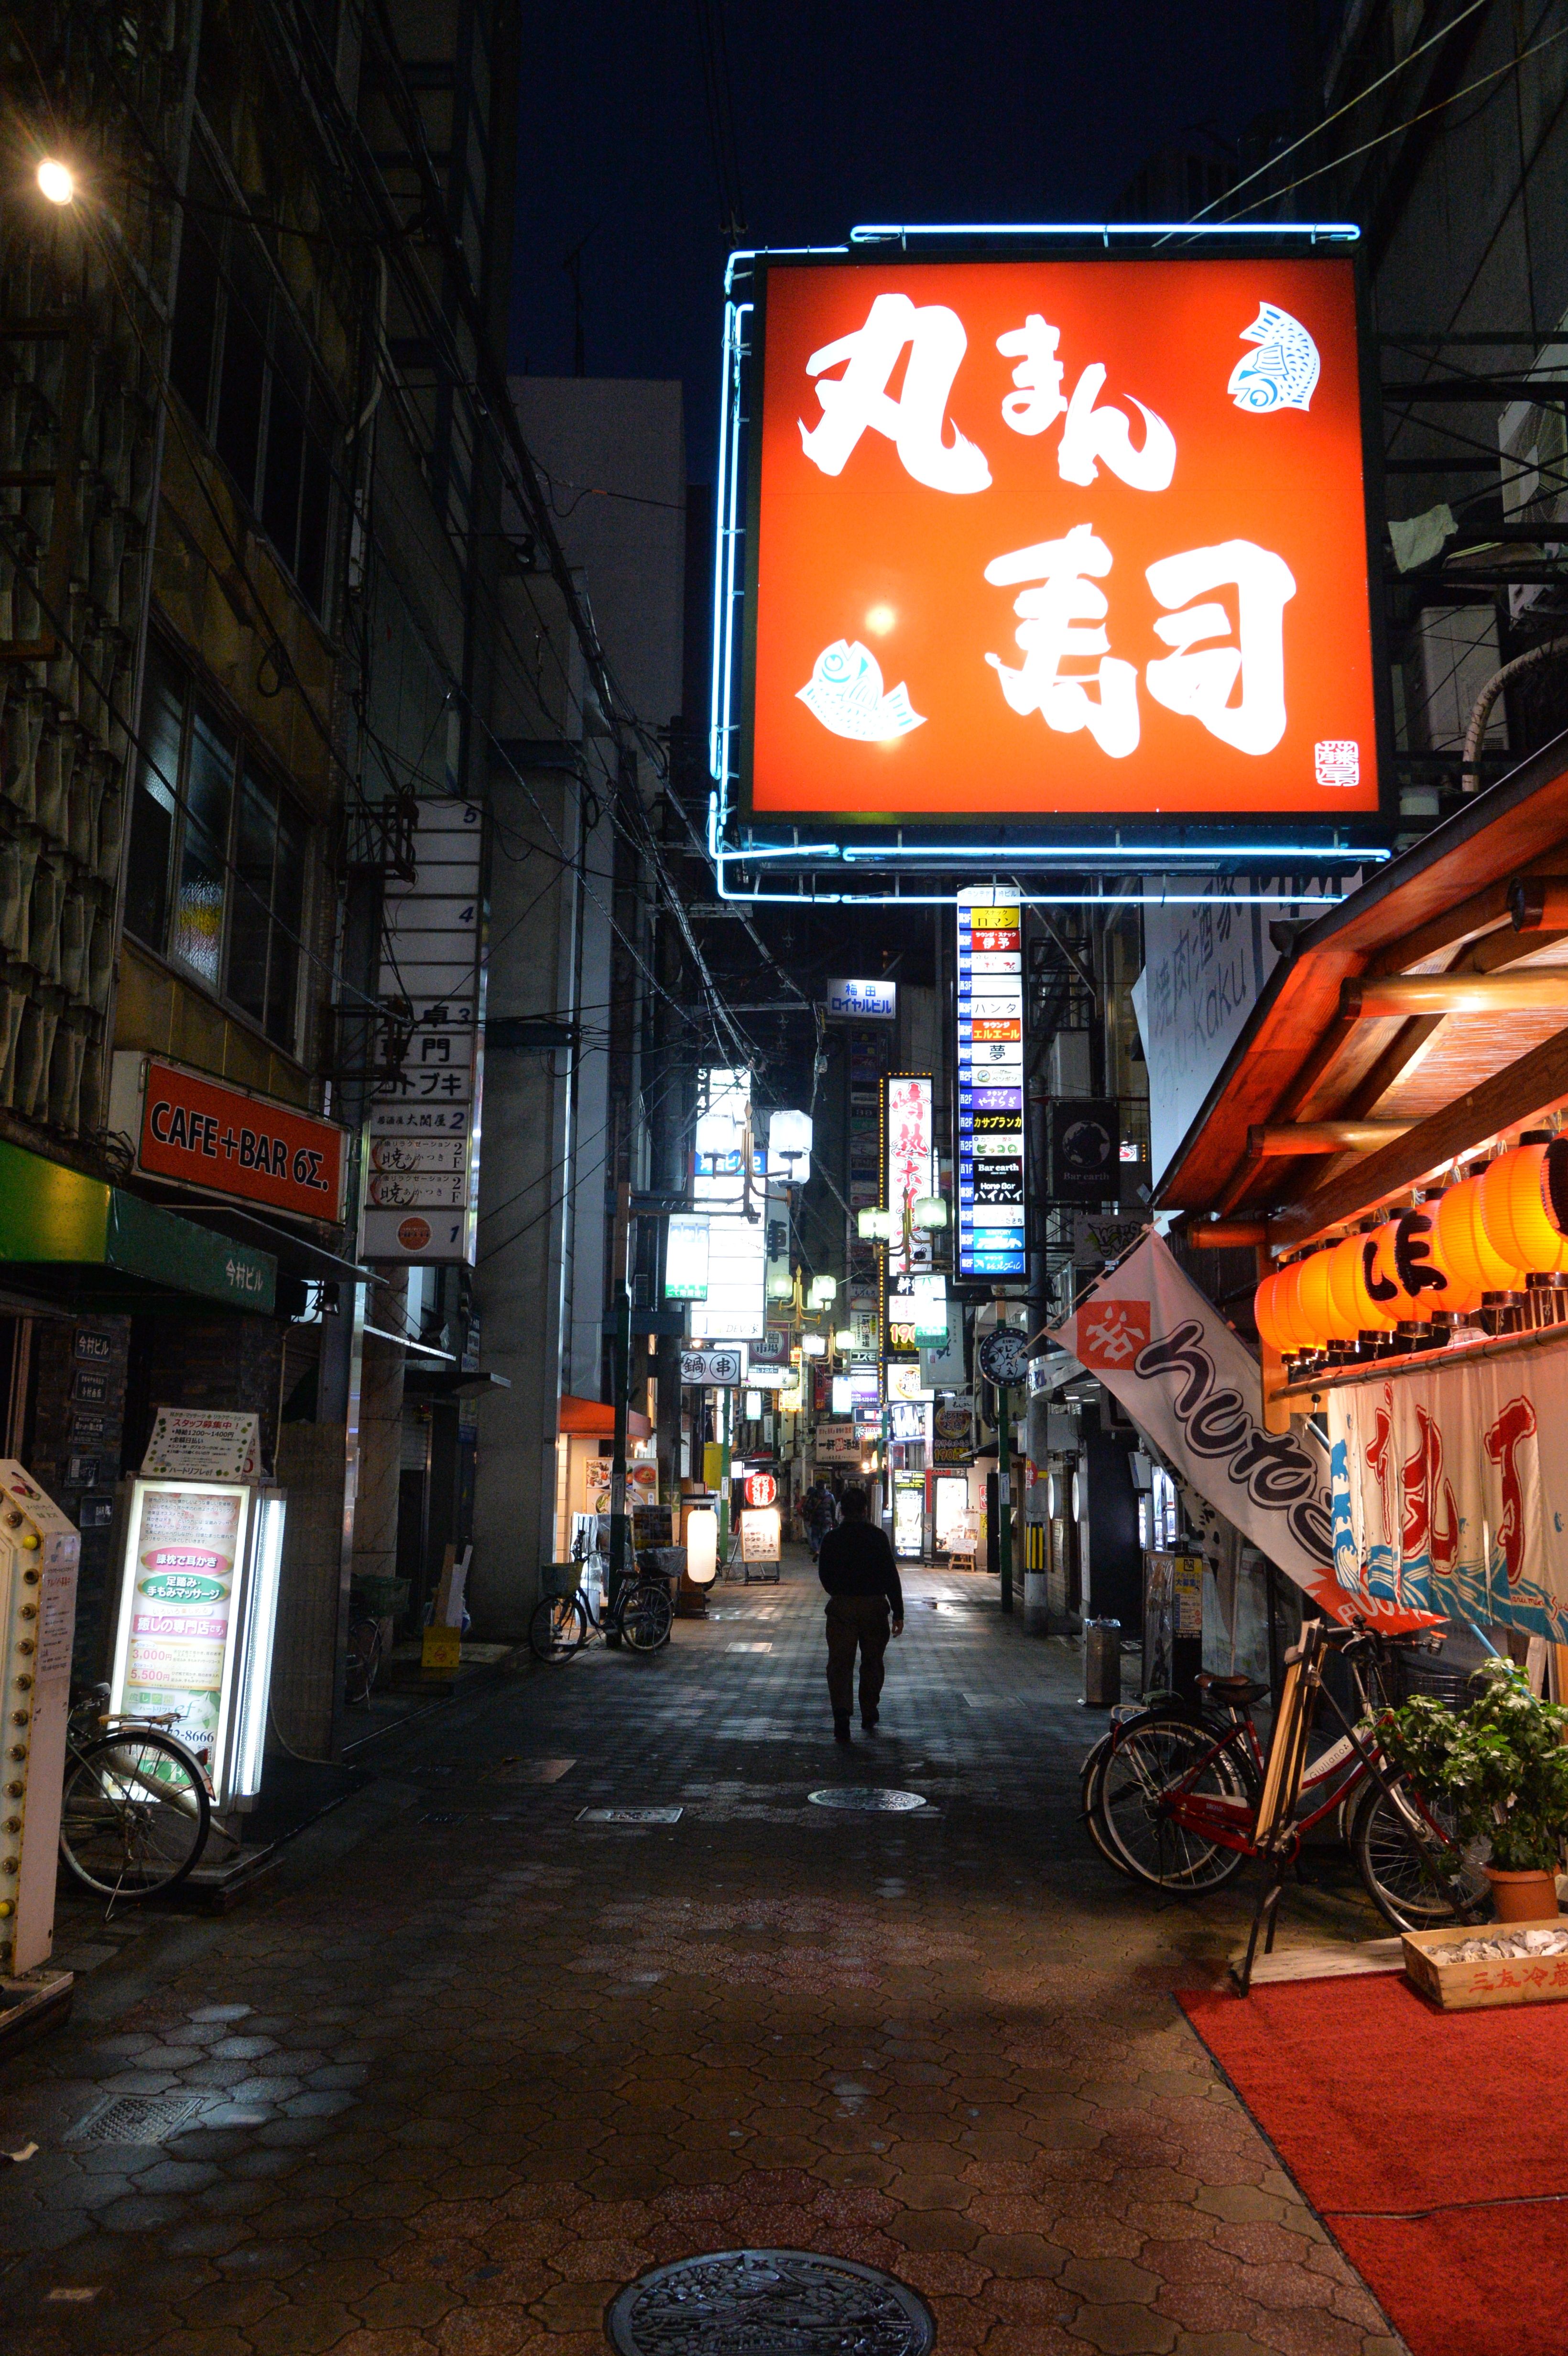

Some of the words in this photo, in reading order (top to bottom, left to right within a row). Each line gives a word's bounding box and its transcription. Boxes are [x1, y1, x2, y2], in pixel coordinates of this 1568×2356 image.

[984, 523, 1296, 757] 寿司
[463, 807, 477, 823] 5
[459, 907, 474, 923] 4
[978, 917, 1014, 927] ロマン
[982, 938, 1010, 949] 伊予
[846, 983, 876, 996] 梅田
[832, 998, 891, 1014] ロイヤルビル
[973, 1029, 1020, 1039] エルエール
[990, 1045, 1005, 1061] 夢
[960, 1094, 972, 1104] 西2F
[979, 1096, 1016, 1107] やすらぎ
[406, 1113, 446, 1127] 大関屋
[449, 1112, 465, 1129] 2
[960, 1117, 972, 1127] 西2F
[974, 1117, 1022, 1127] カサブランカ
[960, 1141, 972, 1150] 西2F
[960, 1164, 972, 1174] 西1F
[995, 1163, 1019, 1171] earth
[1063, 1172, 1079, 1180] Bar
[1083, 1172, 1110, 1180] earth
[974, 1190, 1022, 1201] ハイハイ
[450, 1225, 459, 1243] 1
[225, 1257, 263, 1289] 今村ビル
[78, 1335, 109, 1355] 今村ビル
[756, 1343, 779, 1354] 市場
[852, 1351, 877, 1361] コスモ
[1005, 1345, 1015, 1376] じんべえ
[683, 1357, 705, 1374] 鍋
[716, 1357, 731, 1377] 串
[156, 1553, 218, 1568] 膝枕で耳かき
[147, 1585, 220, 1600] 手もみマッサージ
[132, 1649, 173, 1661] 3,000円
[130, 1669, 171, 1681] 5,500円
